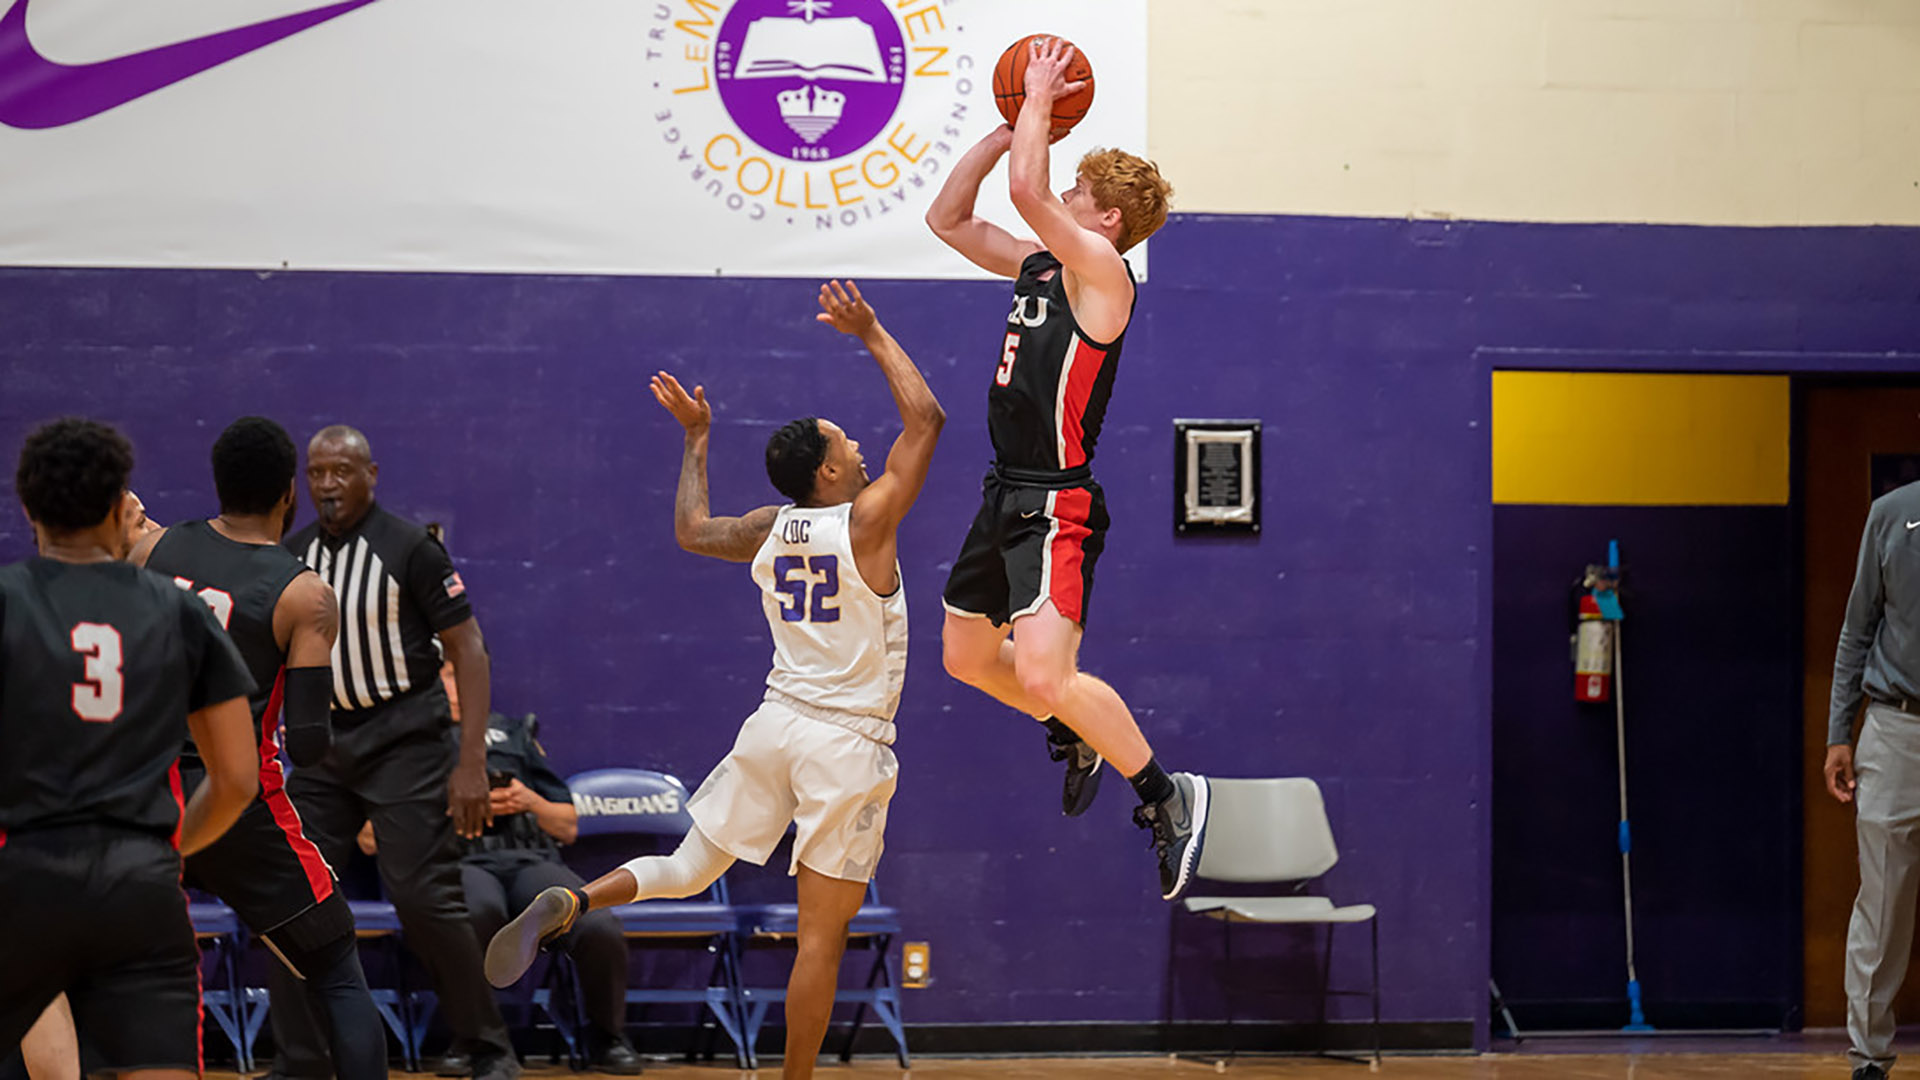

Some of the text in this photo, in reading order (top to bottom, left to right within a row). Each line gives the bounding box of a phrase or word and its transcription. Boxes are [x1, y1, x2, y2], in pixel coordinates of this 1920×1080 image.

[655, 109, 765, 221] COURAGE
[703, 122, 931, 209] COLLEGE
[815, 54, 974, 230] CONSECRATION
[996, 332, 1021, 388] 5
[773, 554, 842, 623] 52
[70, 621, 124, 723] 3
[571, 788, 680, 817] MAGICIANS
